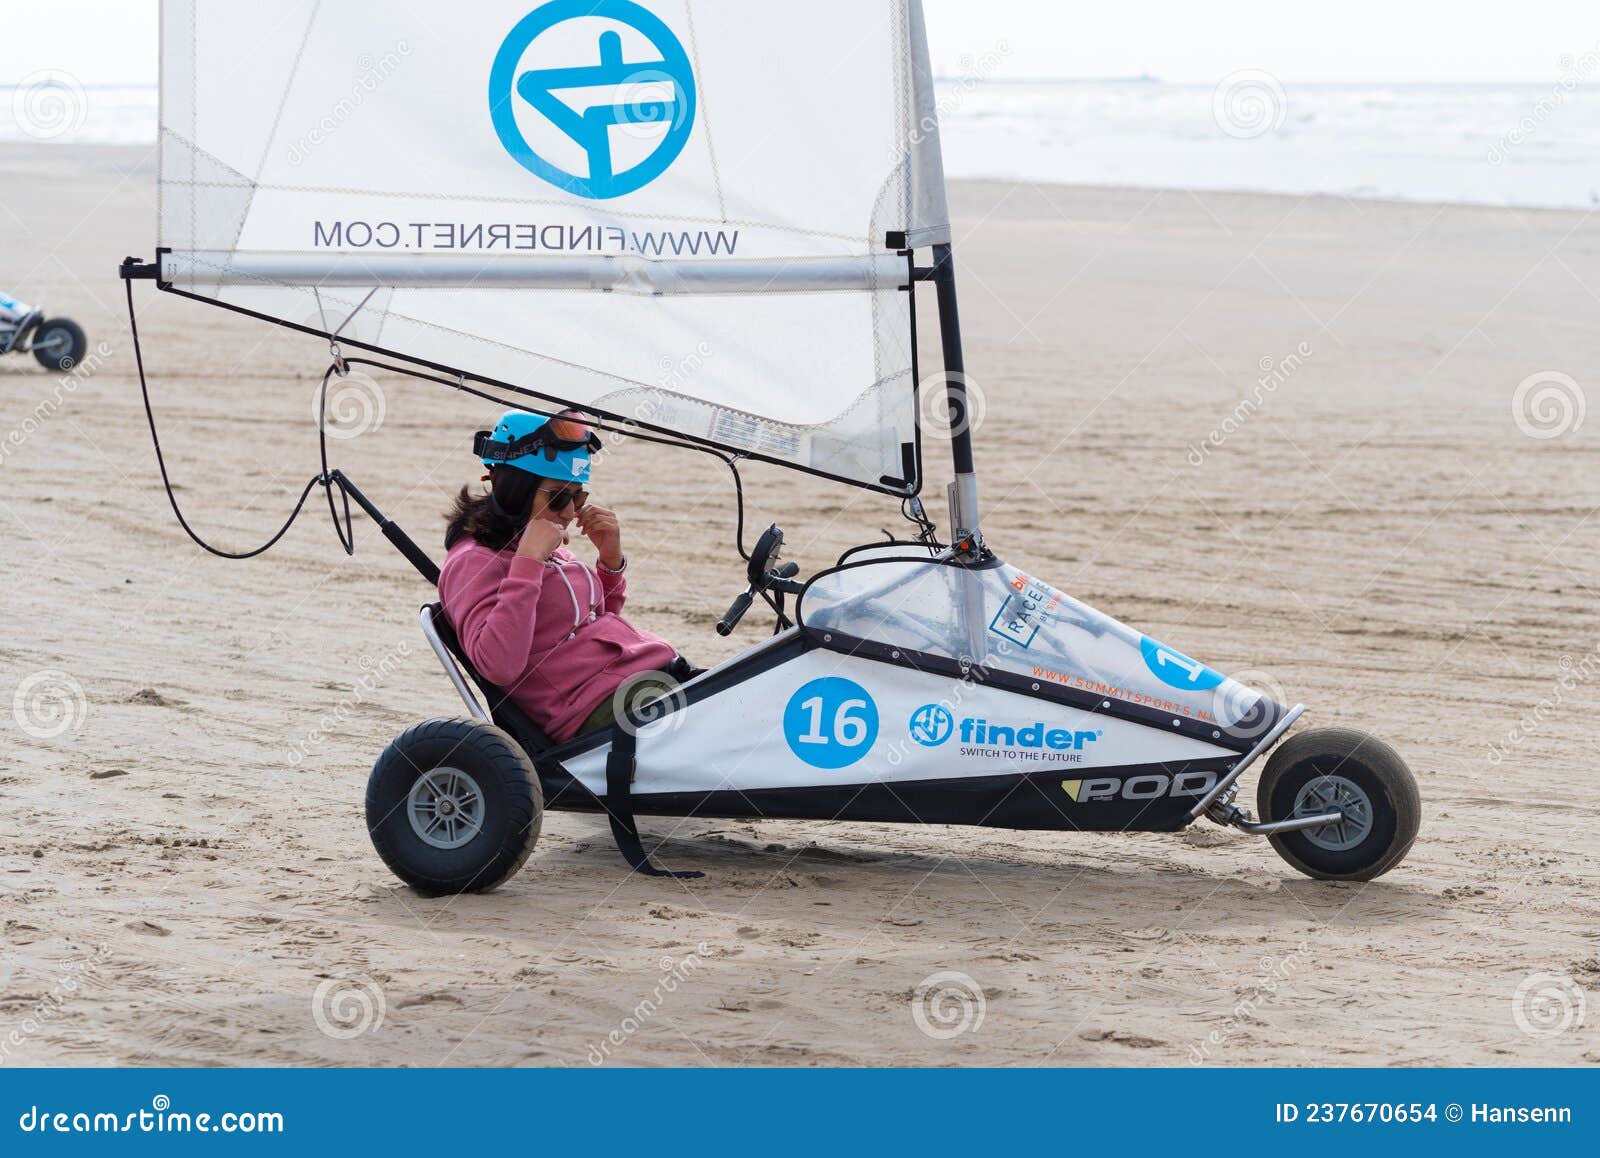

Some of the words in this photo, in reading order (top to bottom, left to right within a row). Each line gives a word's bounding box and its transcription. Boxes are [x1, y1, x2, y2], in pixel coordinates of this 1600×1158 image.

[1007, 590, 1043, 634] RACE
[798, 696, 868, 747] 16
[960, 718, 1097, 750] finder
[960, 747, 1000, 759] SWITCH
[1002, 750, 1017, 760] TO
[1019, 751, 1039, 761] THE
[1042, 752, 1082, 763] FUTURE
[1077, 771, 1218, 803] POD
